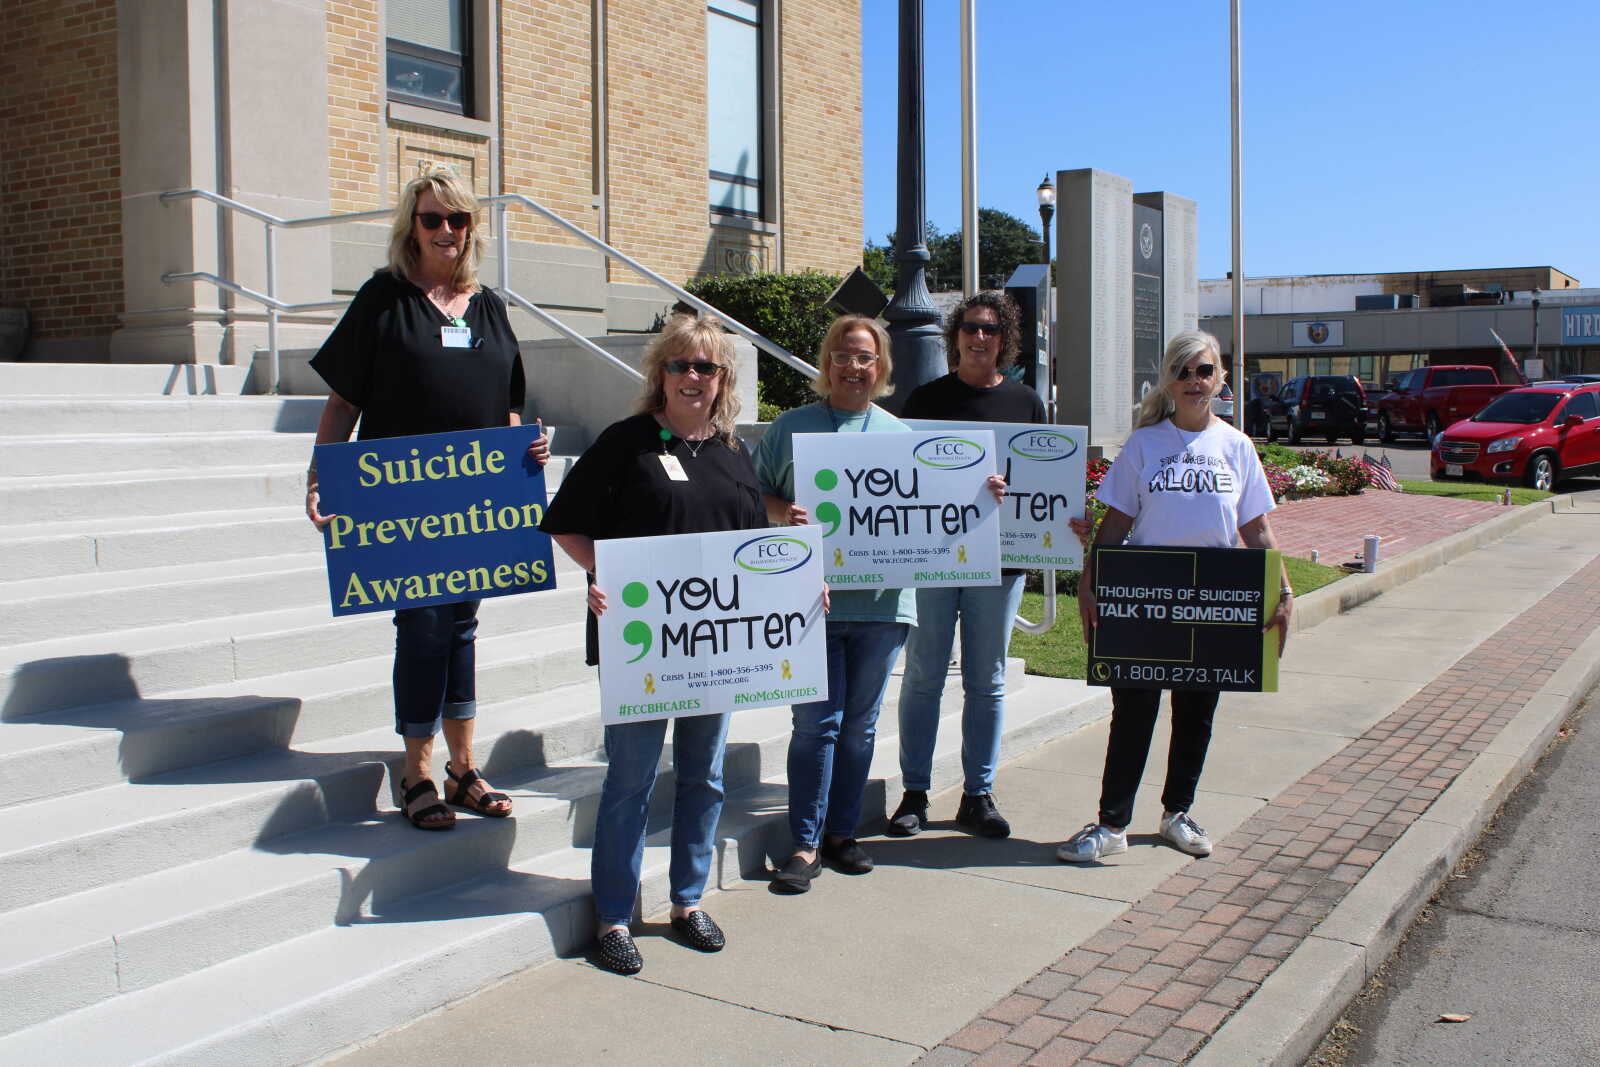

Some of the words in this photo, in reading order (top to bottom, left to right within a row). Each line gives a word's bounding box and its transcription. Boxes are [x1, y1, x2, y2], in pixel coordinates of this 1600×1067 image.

[935, 443, 964, 456] FCC
[1029, 436, 1057, 448] FCC
[358, 440, 506, 488] Suicide
[844, 467, 919, 499] YOU
[1149, 467, 1234, 493] ALONE
[328, 498, 544, 550] Prevention
[757, 542, 790, 558] FCC
[339, 558, 549, 608] Awareness
[656, 574, 740, 615] YOU
[1097, 585, 1173, 600] THOUGHTS
[1177, 588, 1196, 601] OF
[1199, 589, 1261, 603] SUICIDE?
[1097, 602, 1139, 619] TALK
[1144, 604, 1166, 620] TO
[1171, 605, 1258, 622] SOMEONE
[710, 663, 774, 677] 1-800-356-5395
[618, 698, 702, 717] #FCCBHCARES
